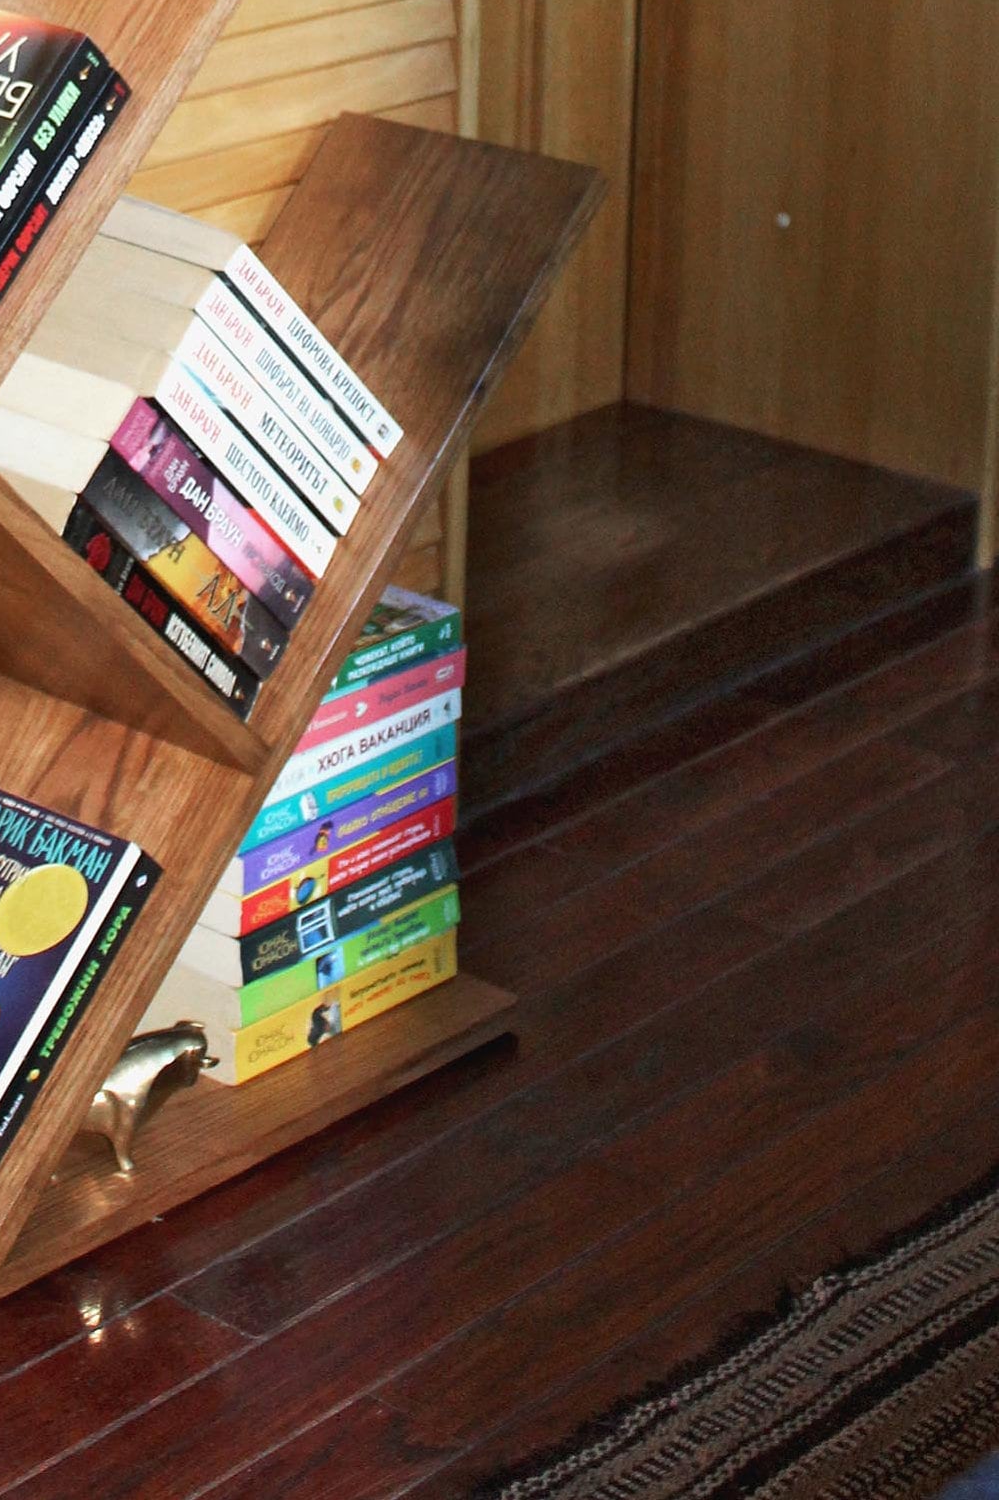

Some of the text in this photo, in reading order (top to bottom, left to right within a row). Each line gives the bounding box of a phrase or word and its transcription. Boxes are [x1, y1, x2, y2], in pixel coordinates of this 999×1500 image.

[32, 118, 57, 151] БЕЗ
[236, 258, 257, 286] ДАН
[193, 340, 218, 372] ДАН
[285, 315, 376, 424] ЦИФРОВА КРЕПОСТ
[169, 382, 194, 413] ДАН
[295, 395, 313, 417] НА
[256, 410, 329, 496] МЕТЕОРИТЪТ
[178, 475, 246, 549] ДАН БРАУН
[223, 440, 311, 544] ШЕСТОТО КЛЕЙМО
[317, 743, 352, 774] ХЮГА
[359, 707, 430, 755] ВАКАНЦИЯ
[27, 823, 113, 884] БАКМАН
[37, 901, 134, 1060] ТРЕВОЖНИ ХОРА
